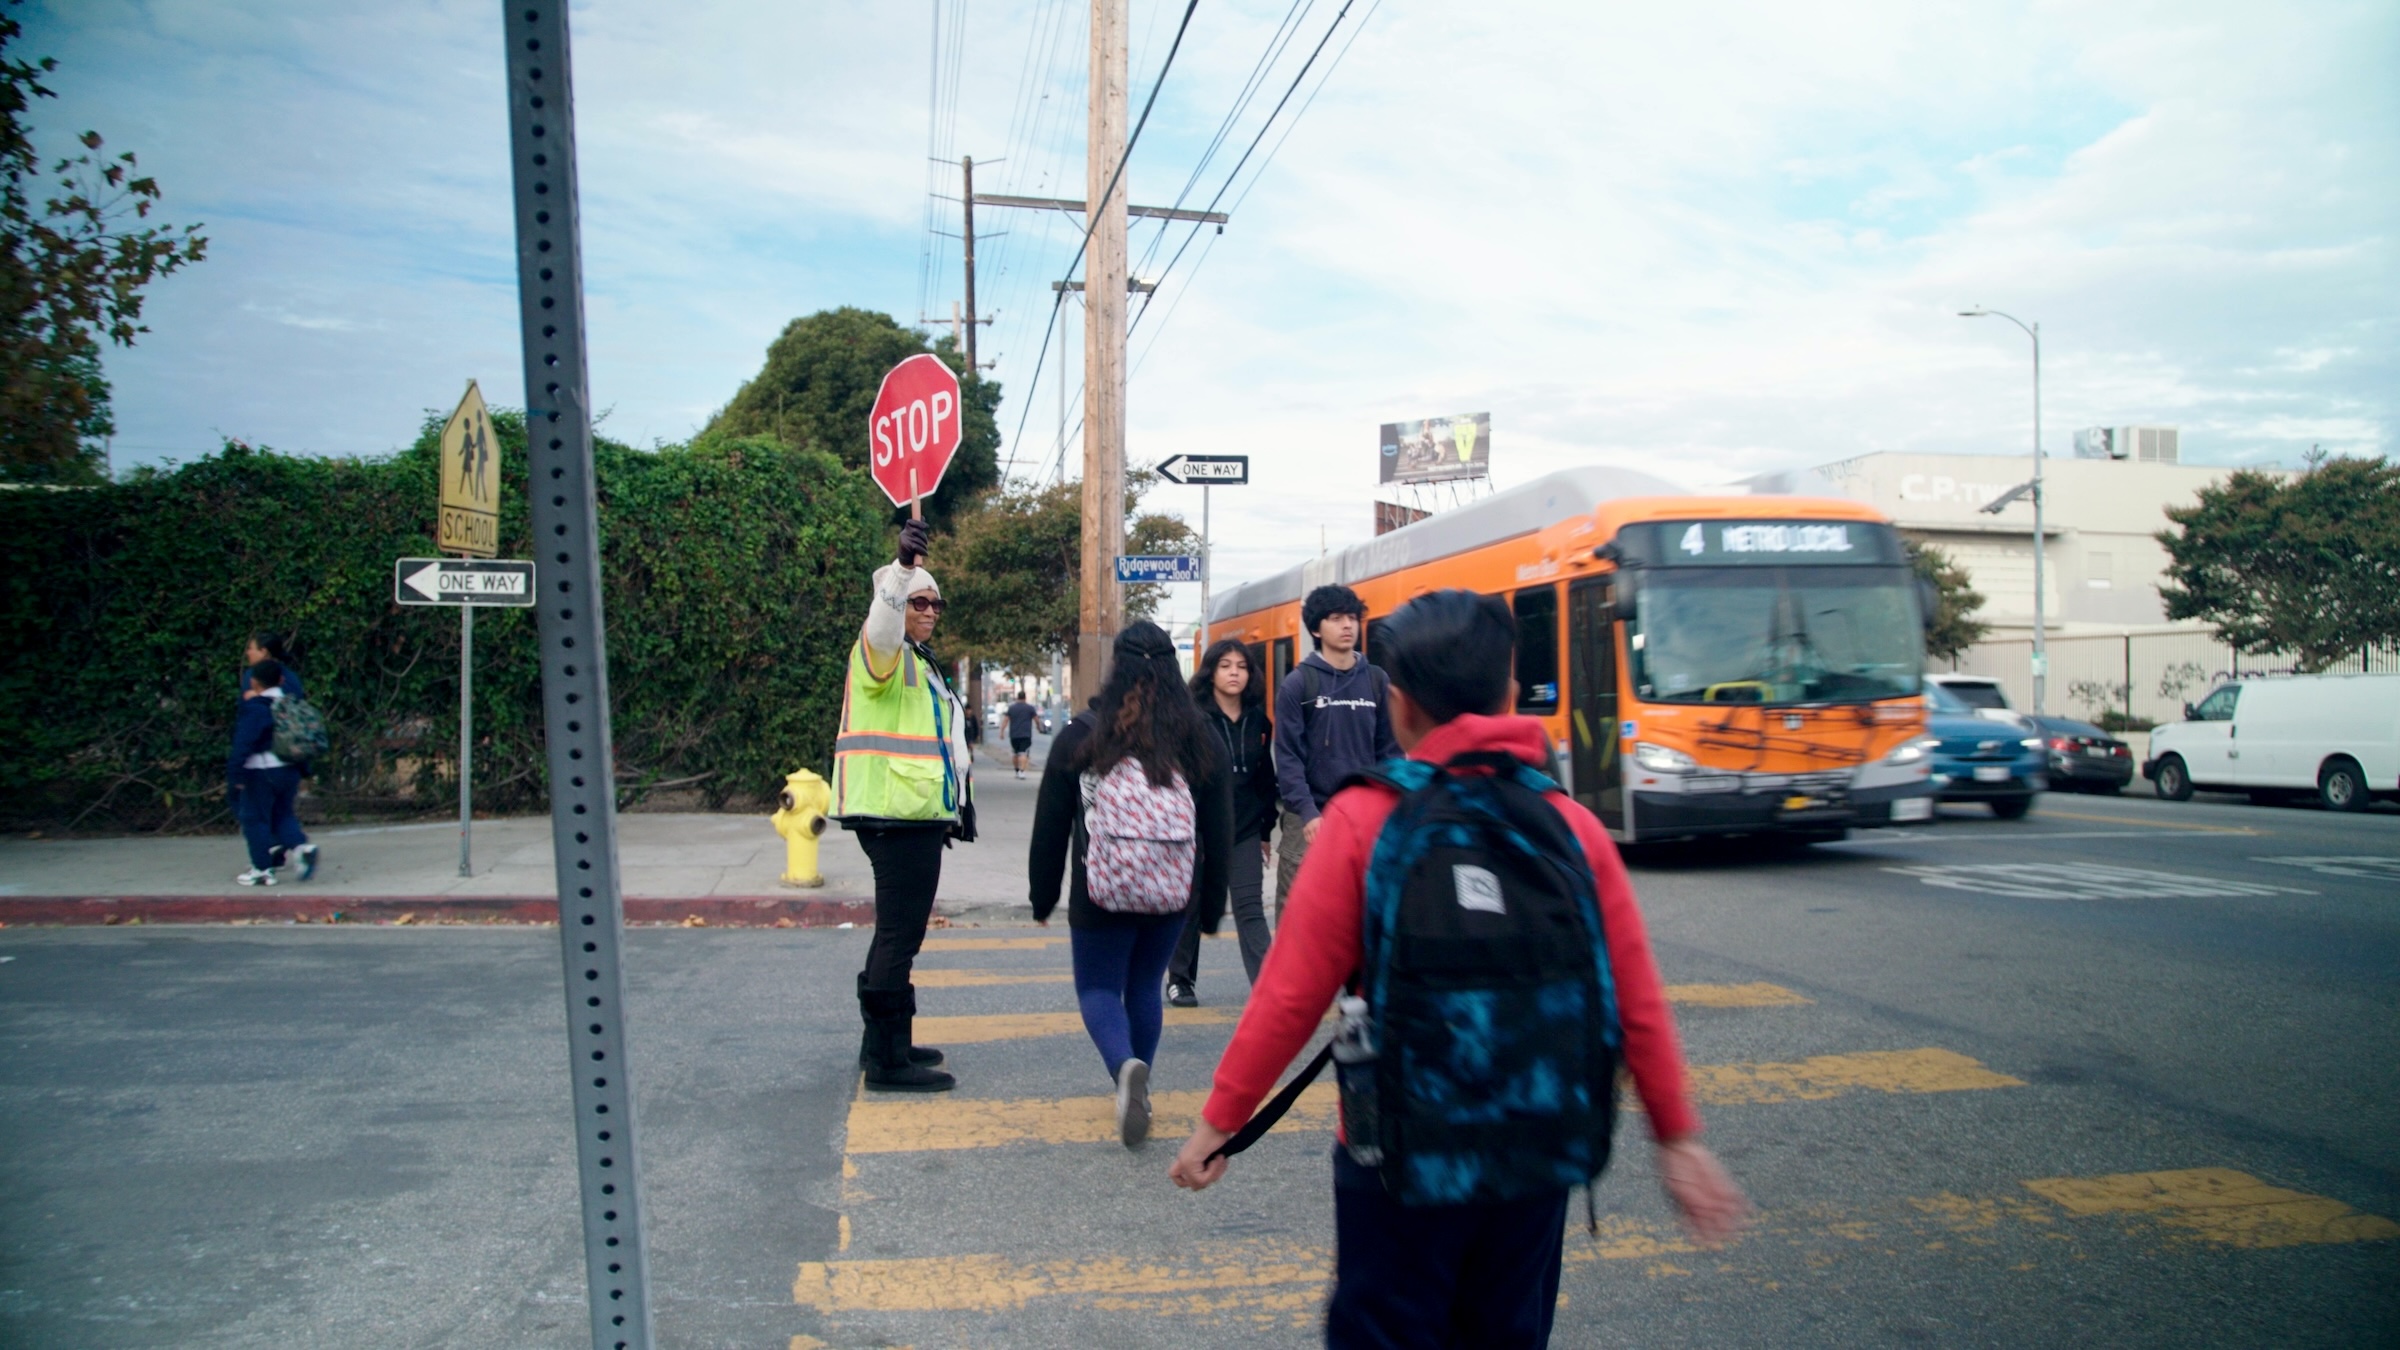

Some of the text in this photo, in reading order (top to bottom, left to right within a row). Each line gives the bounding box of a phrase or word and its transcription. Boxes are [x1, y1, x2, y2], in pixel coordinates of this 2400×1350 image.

[876, 390, 953, 467] STOP
[1183, 464, 1238, 475] ONE WAY
[444, 513, 494, 548] SCHOOL
[1680, 523, 1706, 556] 4
[1119, 557, 1199, 576] Ridgewood Pl
[439, 574, 519, 591] ONE WAY
